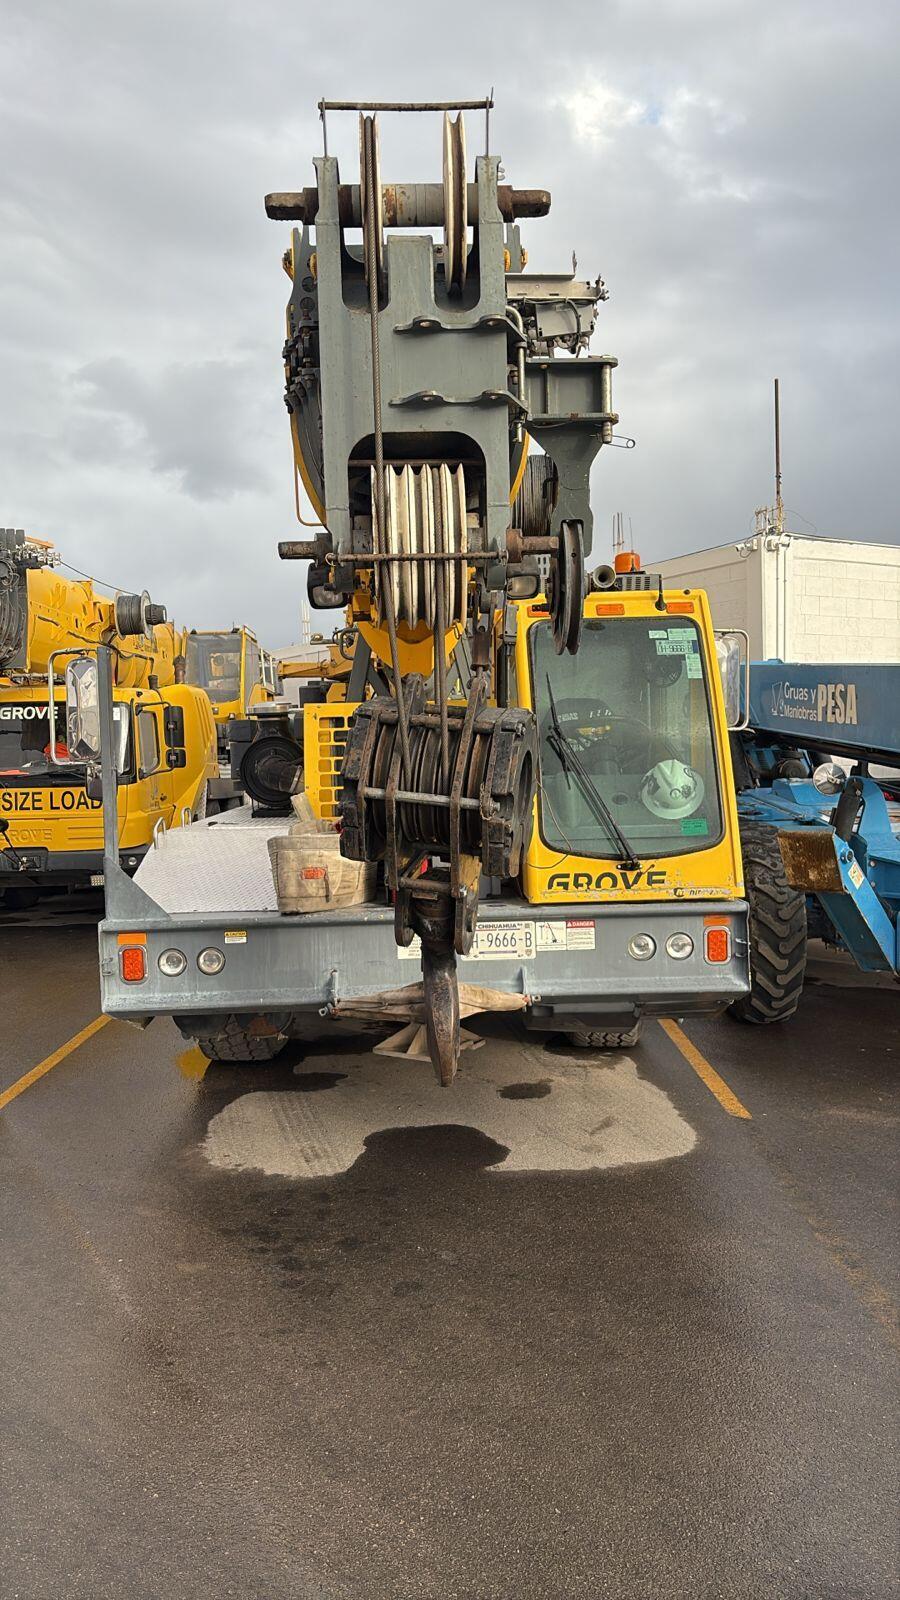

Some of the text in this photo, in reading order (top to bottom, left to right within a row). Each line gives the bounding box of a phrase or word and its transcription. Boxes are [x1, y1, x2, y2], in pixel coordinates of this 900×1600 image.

[810, 688, 817, 704] y
[817, 683, 858, 725] PESA
[0, 706, 59, 720] GROVE
[784, 705, 817, 721] Maniobras
[547, 871, 667, 891] GROVE
